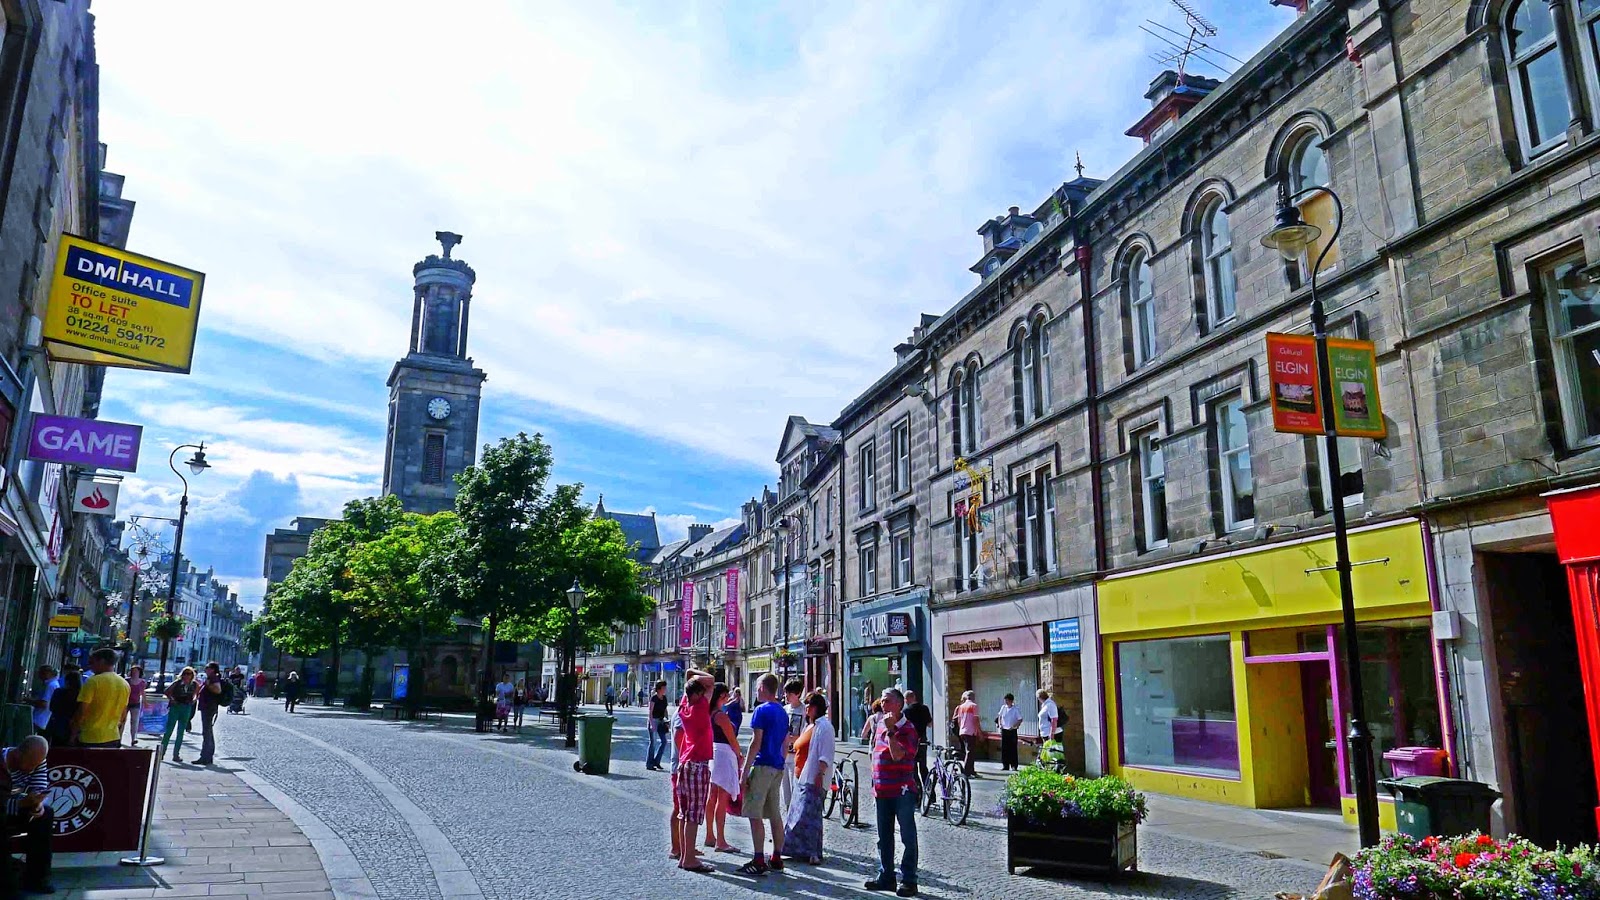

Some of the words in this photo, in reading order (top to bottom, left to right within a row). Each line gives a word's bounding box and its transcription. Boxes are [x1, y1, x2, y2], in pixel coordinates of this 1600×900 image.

[72, 282, 106, 299] Office
[111, 294, 138, 307] suite
[121, 270, 181, 298] HALL
[67, 305, 79, 315] 38
[107, 316, 128, 327] (409
[70, 292, 92, 309] TO
[98, 301, 130, 319] LET
[66, 315, 110, 335] 01224
[116, 327, 165, 349] 594172
[1279, 347, 1303, 356] Cultural
[1275, 361, 1309, 375] ELGIN
[1335, 367, 1367, 380] ELGIN
[37, 426, 133, 459] GAME
[728, 572, 737, 603] shopping
[728, 604, 737, 626] centre
[860, 614, 887, 638] ESQUIR
[48, 768, 94, 788] OSTA
[52, 806, 95, 833] FEE
